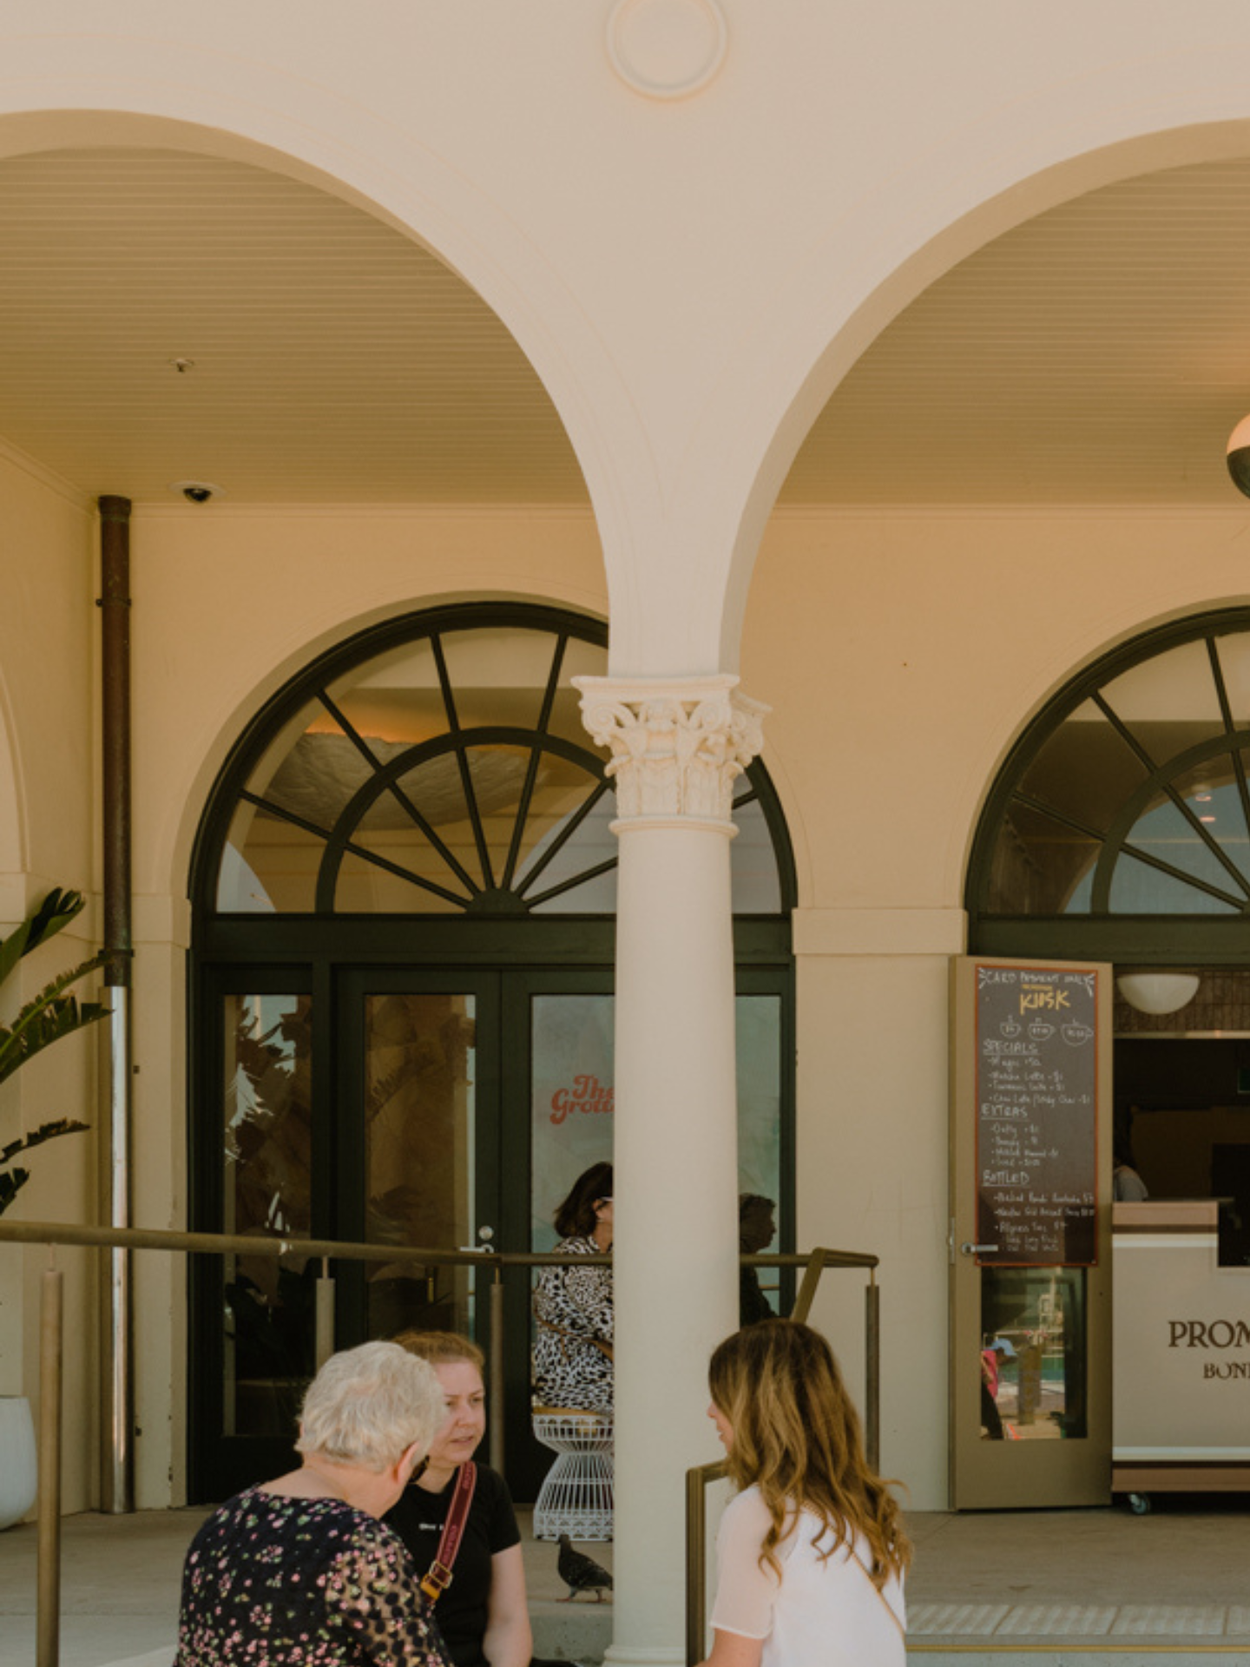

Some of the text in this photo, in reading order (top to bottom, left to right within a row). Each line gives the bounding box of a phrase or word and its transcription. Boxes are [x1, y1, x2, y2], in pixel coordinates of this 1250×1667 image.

[1019, 989, 1071, 1015] KIOSK
[983, 1038, 1039, 1054] SPECIALS
[981, 1102, 1028, 1118] EXTRAS
